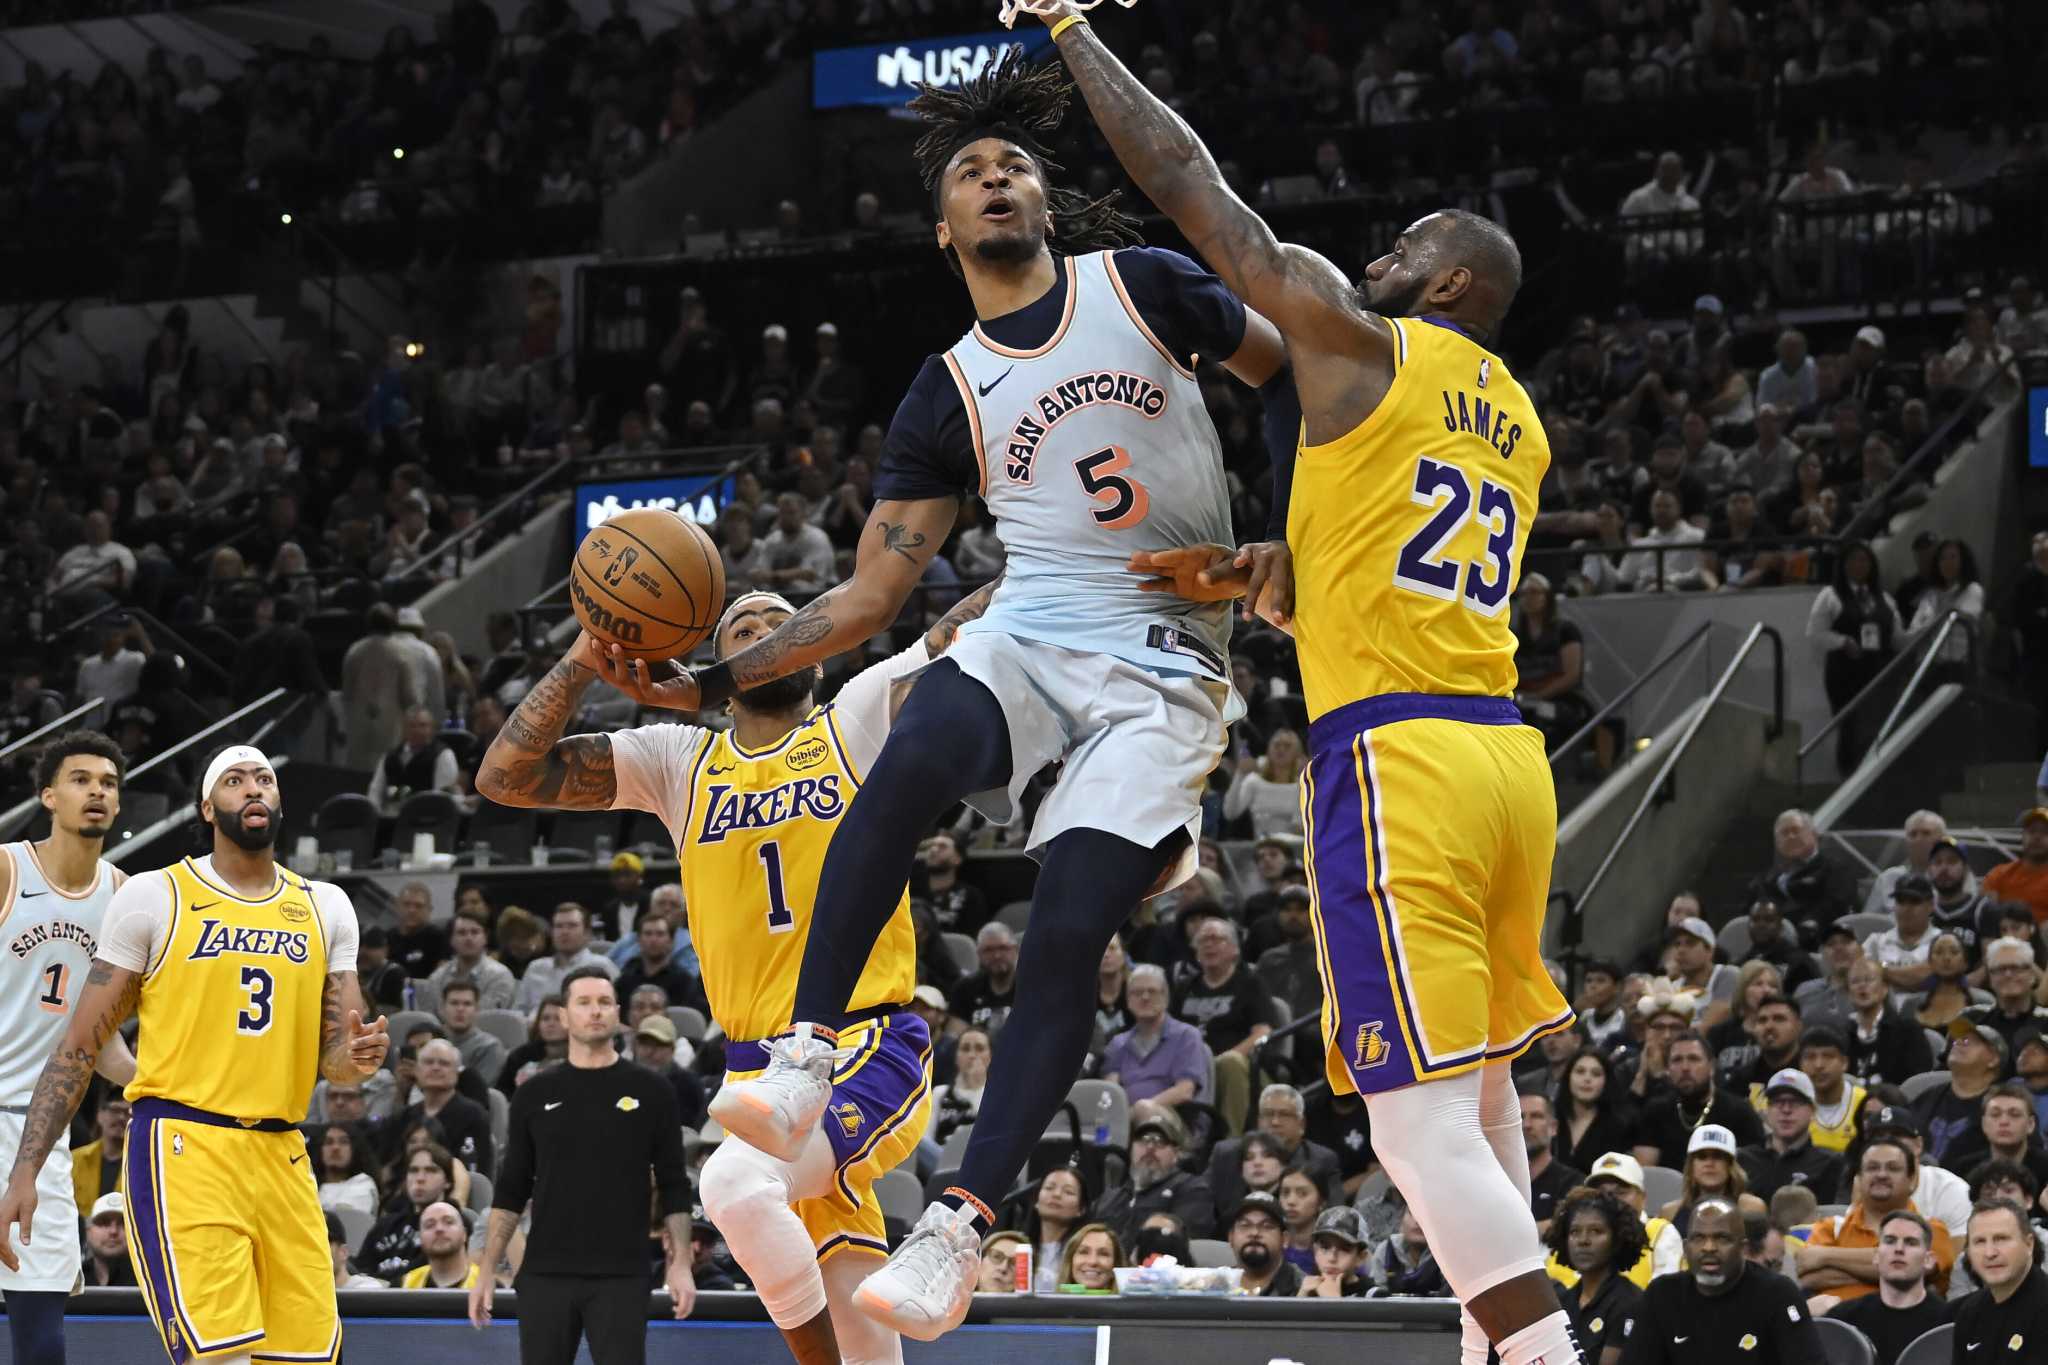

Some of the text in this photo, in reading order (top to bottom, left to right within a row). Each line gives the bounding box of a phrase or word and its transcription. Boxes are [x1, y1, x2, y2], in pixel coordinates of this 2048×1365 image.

[1006, 372, 1166, 484] SAN ANTONIO
[1442, 390, 1522, 460] JAMES
[1074, 446, 1148, 530] 5
[1393, 455, 1517, 617] 23
[789, 744, 826, 763] bibigo
[697, 774, 844, 845] LAKERS
[758, 840, 794, 934] 1
[11, 921, 98, 962] SAN ANTON
[187, 919, 309, 963] LAKERS
[40, 962, 69, 1012] 1
[237, 966, 273, 1036] 3
